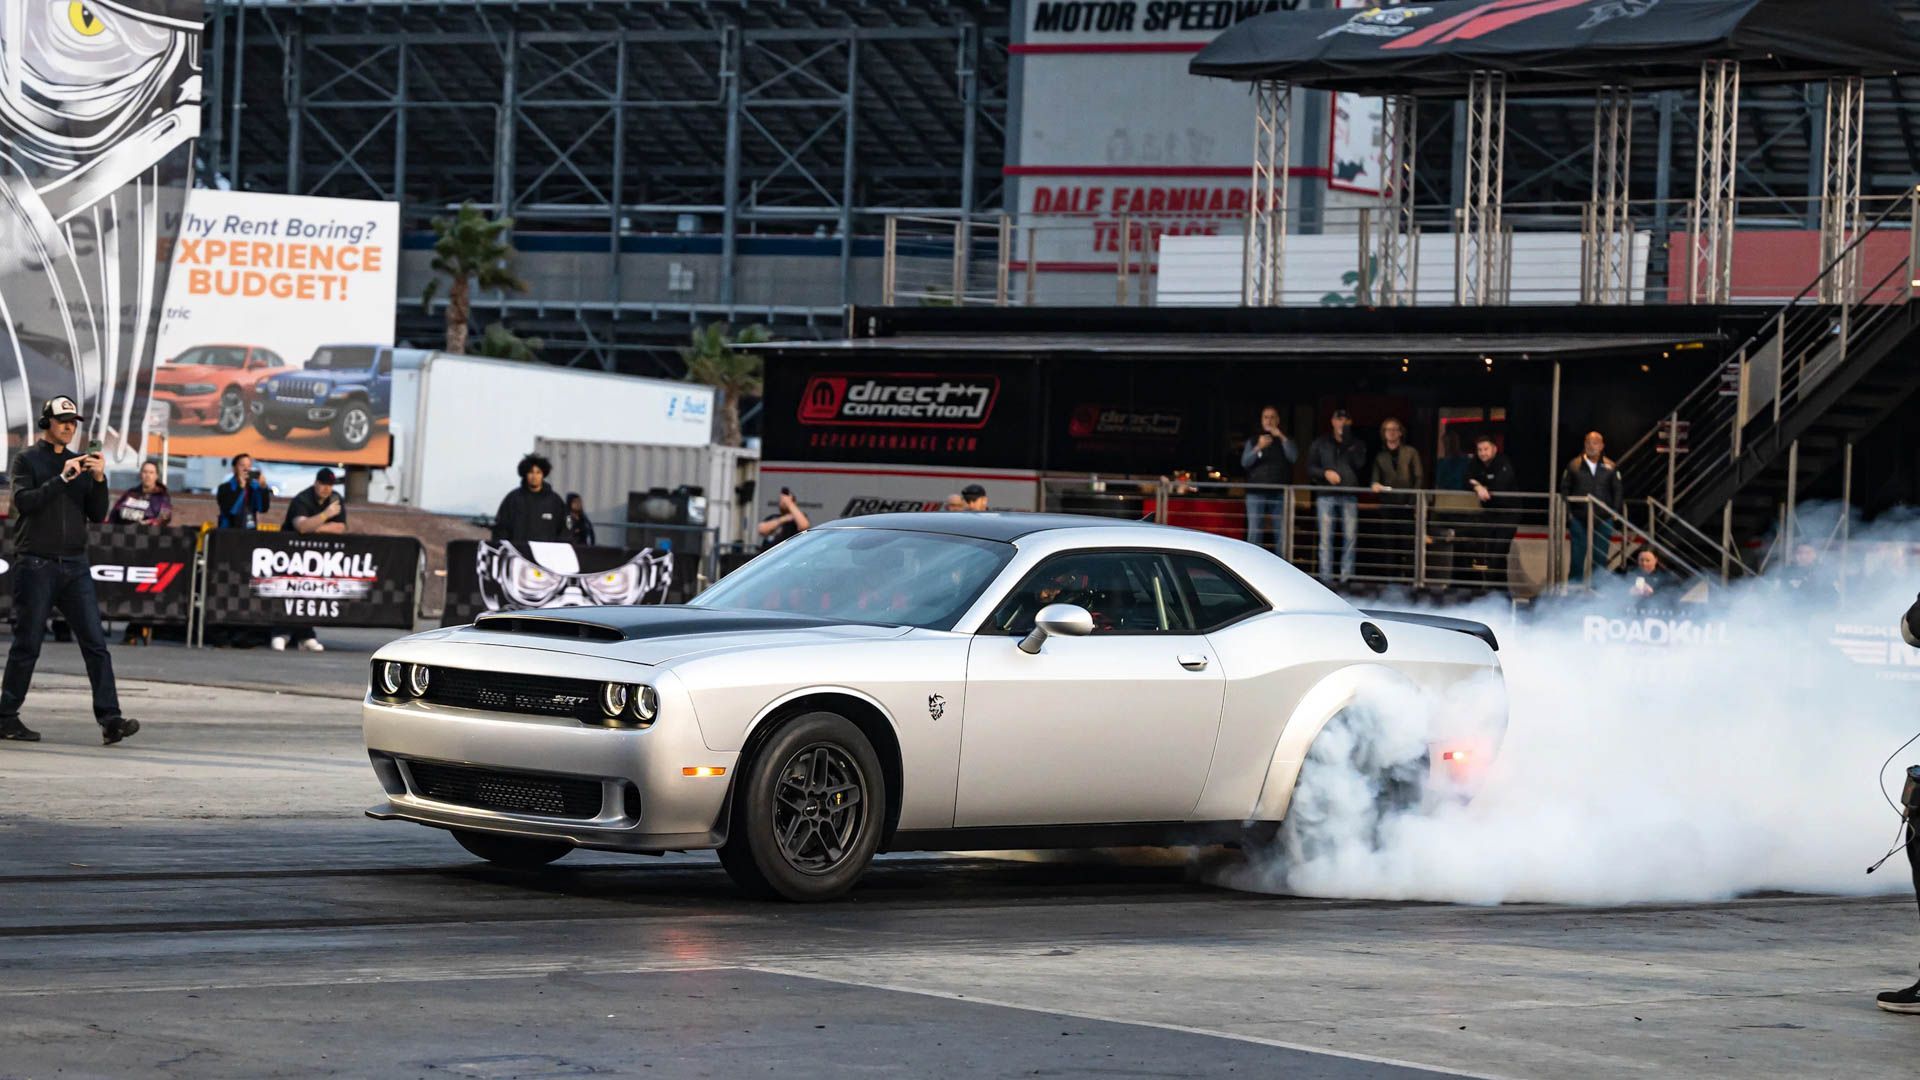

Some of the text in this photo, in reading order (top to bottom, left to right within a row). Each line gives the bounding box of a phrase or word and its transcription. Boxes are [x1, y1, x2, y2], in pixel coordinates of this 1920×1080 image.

[1034, 1, 1136, 31] MOTOR
[1032, 186, 1104, 217] DALE
[224, 215, 278, 236] Rent
[286, 218, 377, 244] Boring?
[188, 269, 348, 302] BUDGET!
[848, 381, 966, 402] direct
[842, 402, 977, 418] connection
[285, 599, 339, 618] VEGAS
[552, 695, 589, 706] SRT
